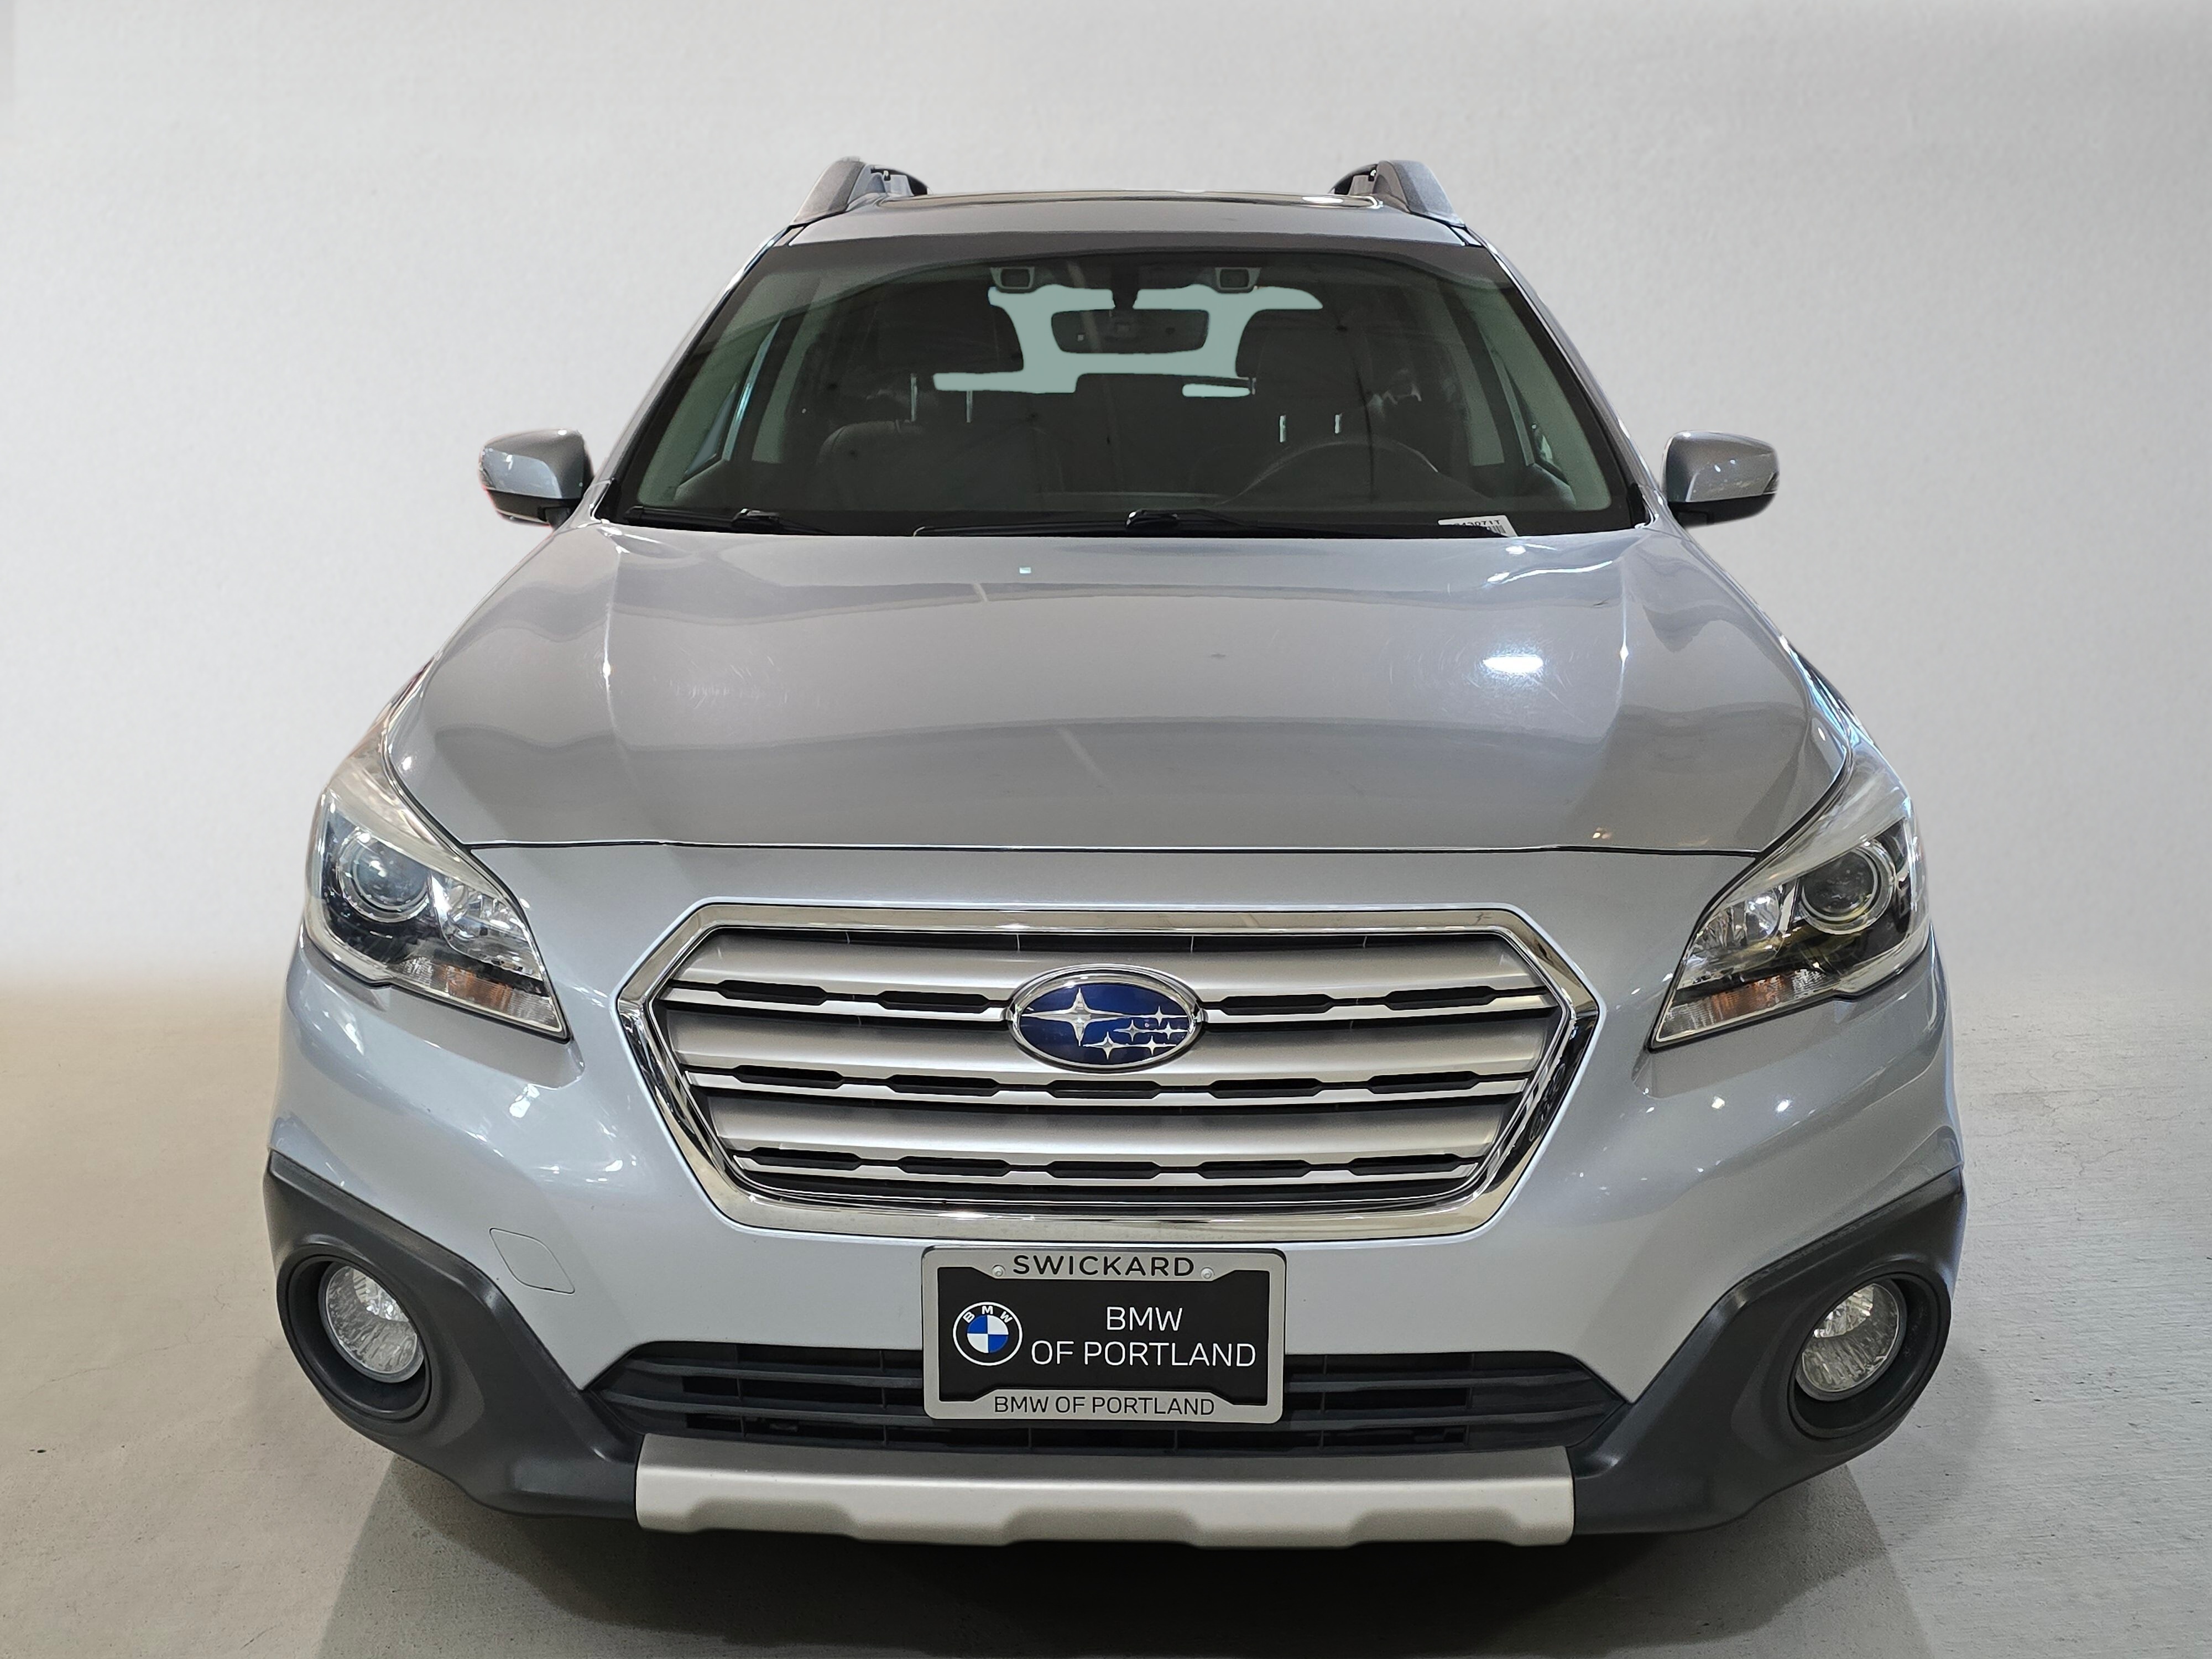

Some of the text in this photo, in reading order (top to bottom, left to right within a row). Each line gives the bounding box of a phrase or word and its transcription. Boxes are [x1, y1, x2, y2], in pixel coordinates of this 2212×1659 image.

[1013, 1255, 1194, 1277] SWICKARD
[963, 1306, 1014, 1325] BMW
[1106, 1306, 1183, 1332] BMW
[1031, 1340, 1256, 1367] OF PORTLAND
[994, 1396, 1215, 1416] BMW OF PORTLAND
